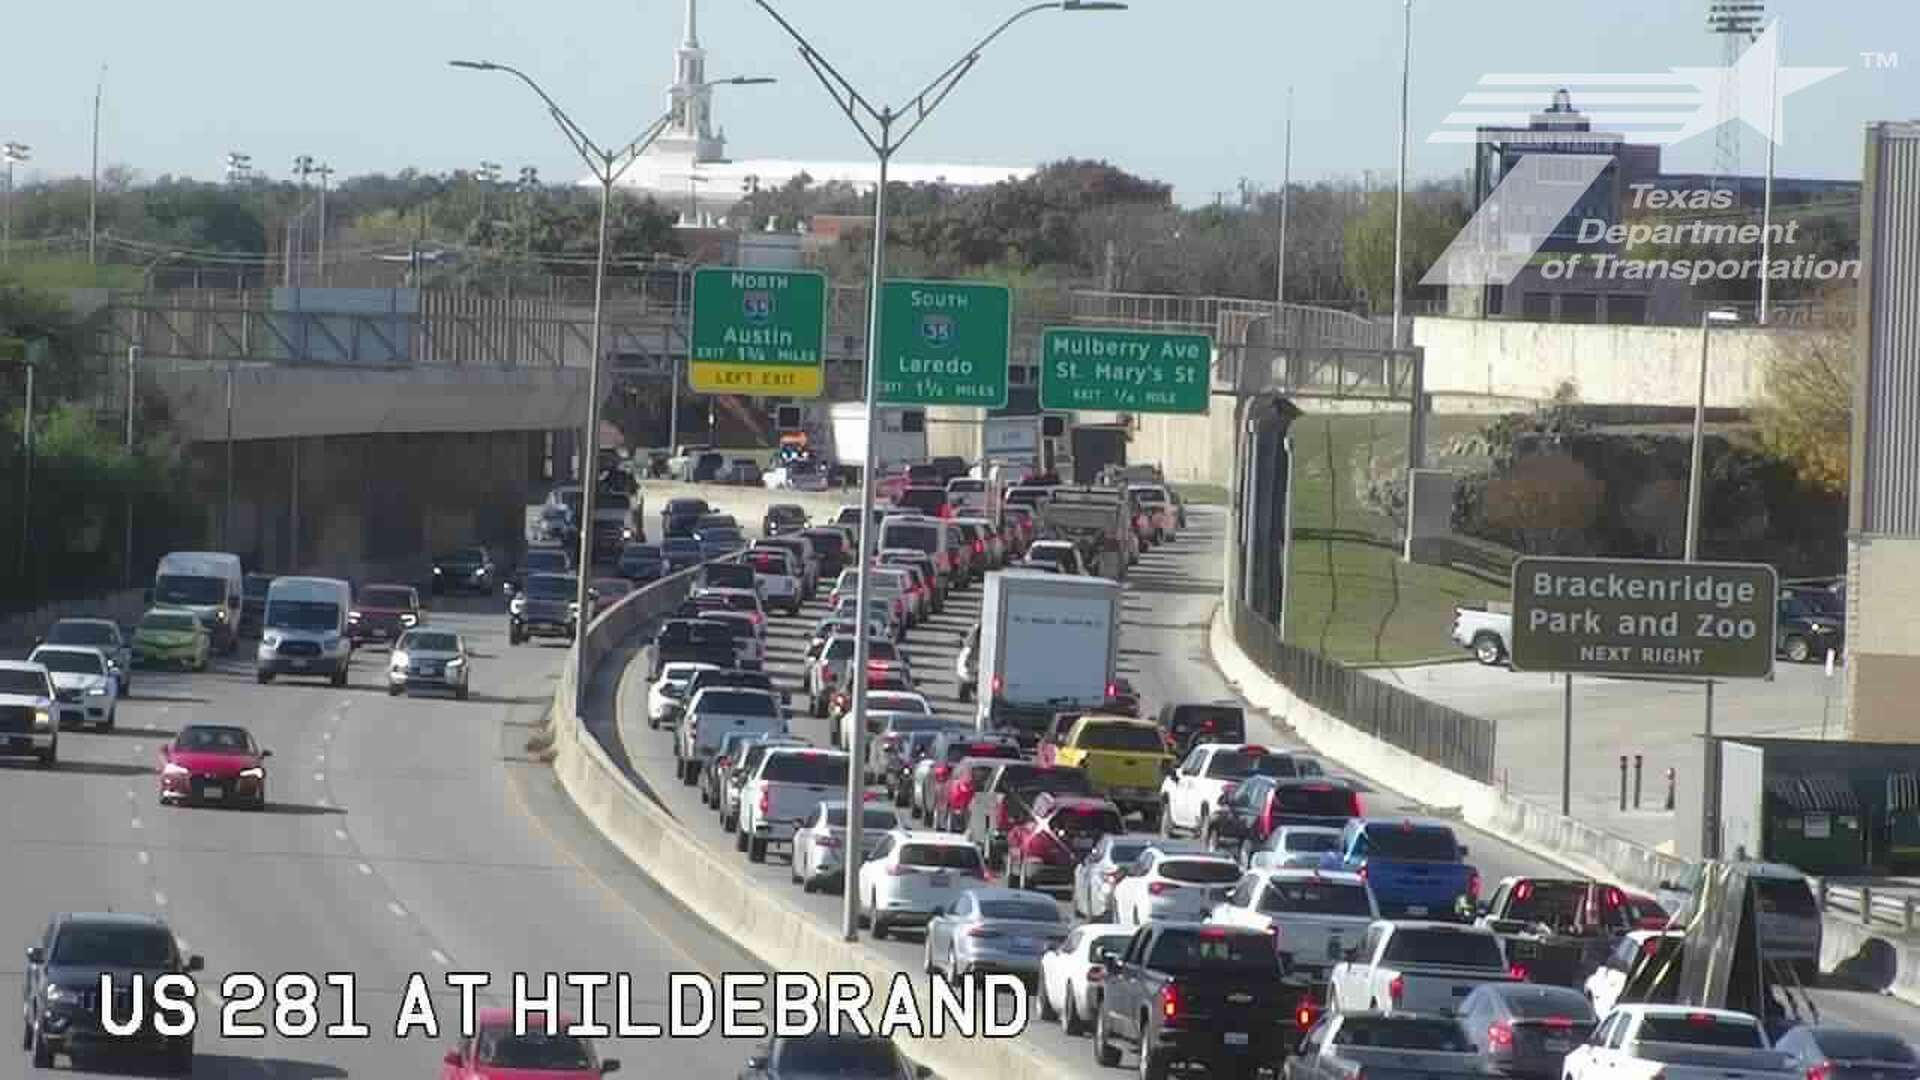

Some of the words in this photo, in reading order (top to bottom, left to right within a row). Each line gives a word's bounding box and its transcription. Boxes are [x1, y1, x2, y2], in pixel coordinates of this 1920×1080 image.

[731, 272, 789, 291] NORTH
[911, 289, 969, 308] SOUTH
[723, 325, 793, 346] Austin
[697, 347, 725, 361] EXIT
[778, 348, 817, 362] MILES
[1054, 336, 1151, 361] Mulberry
[1160, 341, 1200, 360] Ave
[900, 355, 973, 375] Laredo
[1095, 363, 1163, 385] Mary's
[1175, 365, 1196, 384] St
[715, 371, 753, 385] LEFT
[955, 383, 995, 397] MILES
[1073, 388, 1102, 400] EXIT
[1145, 391, 1177, 404] MILE
[1534, 572, 1755, 608] Brackenridge
[1530, 609, 1601, 634] Park
[1618, 612, 1680, 637] and
[1696, 614, 1757, 639] Zoo
[1581, 647, 1632, 662] NEXT
[1642, 648, 1705, 664] RIGHT
